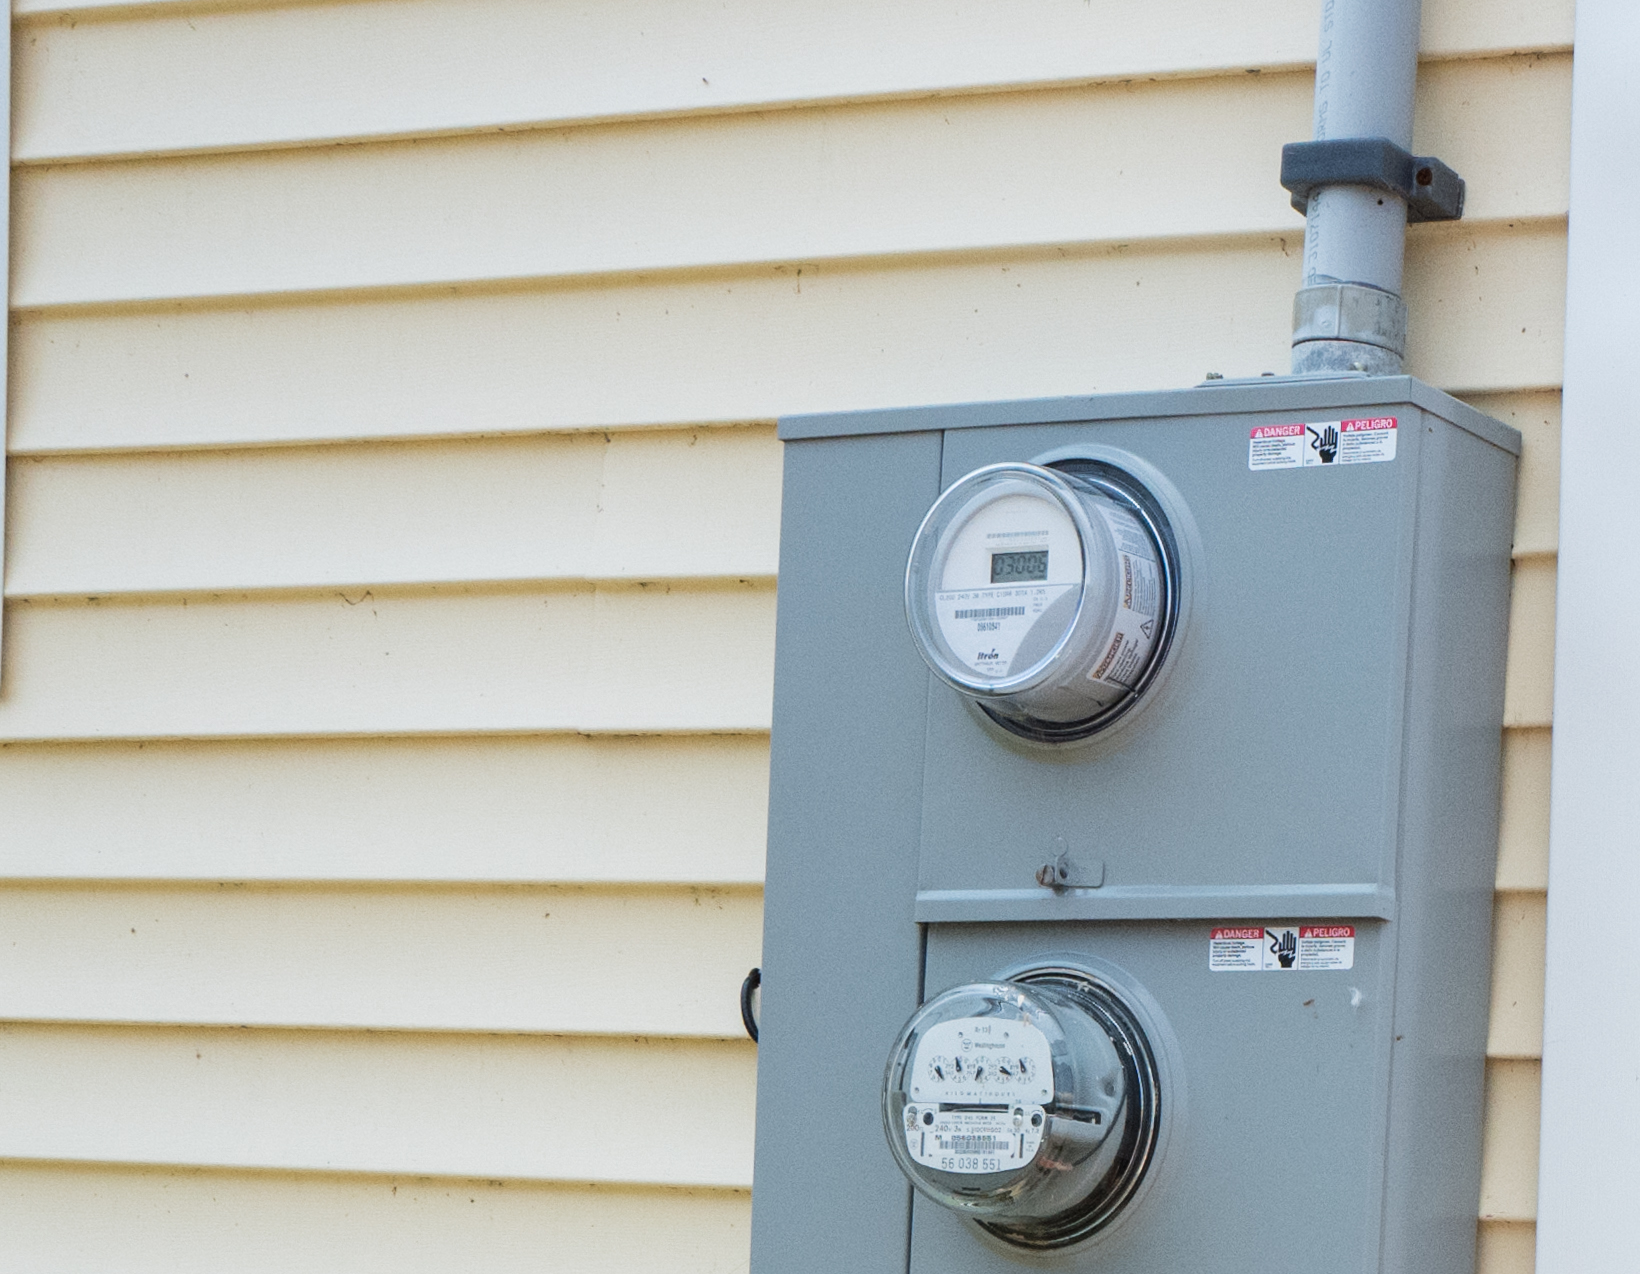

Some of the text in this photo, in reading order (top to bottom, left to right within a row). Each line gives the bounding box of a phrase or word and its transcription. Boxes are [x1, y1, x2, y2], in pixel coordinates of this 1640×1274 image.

[1355, 419, 1393, 430] PELIGRO
[1264, 427, 1301, 437] DANGER
[1223, 929, 1260, 939] DANGER
[1313, 927, 1351, 938] PELIGRO
[941, 1158, 1001, 1170] 56 038 551
